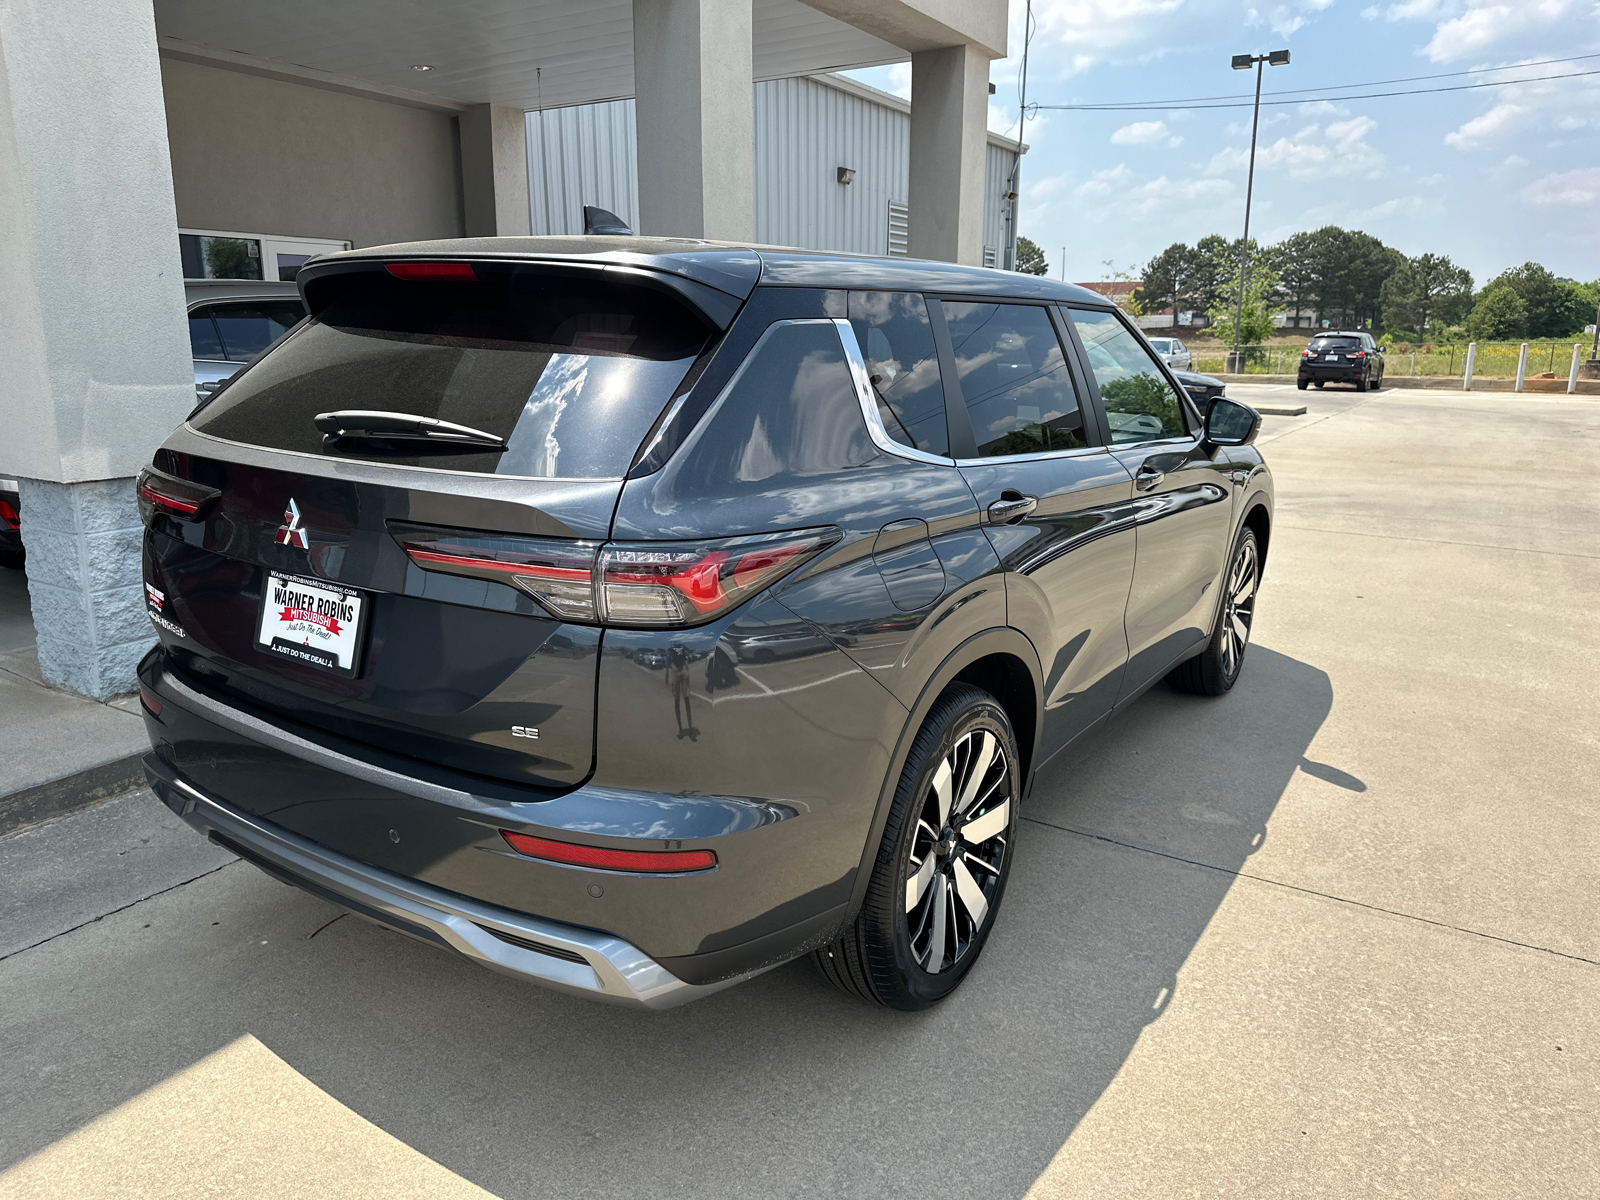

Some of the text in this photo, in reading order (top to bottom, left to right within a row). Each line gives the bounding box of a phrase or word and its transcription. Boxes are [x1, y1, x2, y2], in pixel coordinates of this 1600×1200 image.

[274, 586, 354, 623] WARNER ROBINS
[290, 608, 332, 628] MITSUBISHI
[286, 621, 332, 640] Just Do The Deal!
[276, 645, 328, 666] JUST DO THE DEAL!
[511, 725, 539, 740] SE
